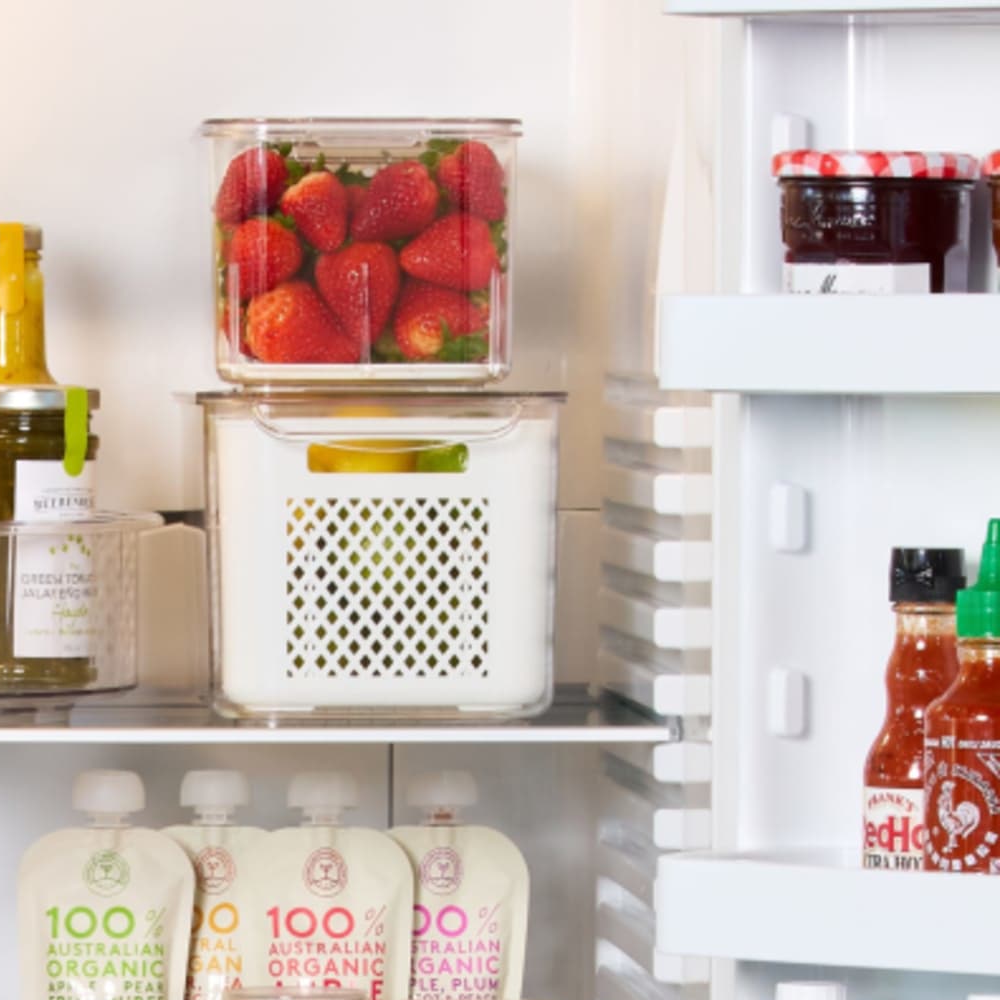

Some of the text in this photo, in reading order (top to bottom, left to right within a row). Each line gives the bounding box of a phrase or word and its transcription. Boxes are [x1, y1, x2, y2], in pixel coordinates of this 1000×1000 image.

[48, 943, 164, 956] AUSTRALIAN
[268, 941, 386, 956] AUSTRALIAN
[46, 960, 164, 978] ORGANIC
[268, 957, 384, 977] ORGANIC
[411, 956, 499, 975] GANIC
[452, 978, 499, 992] PLUM
